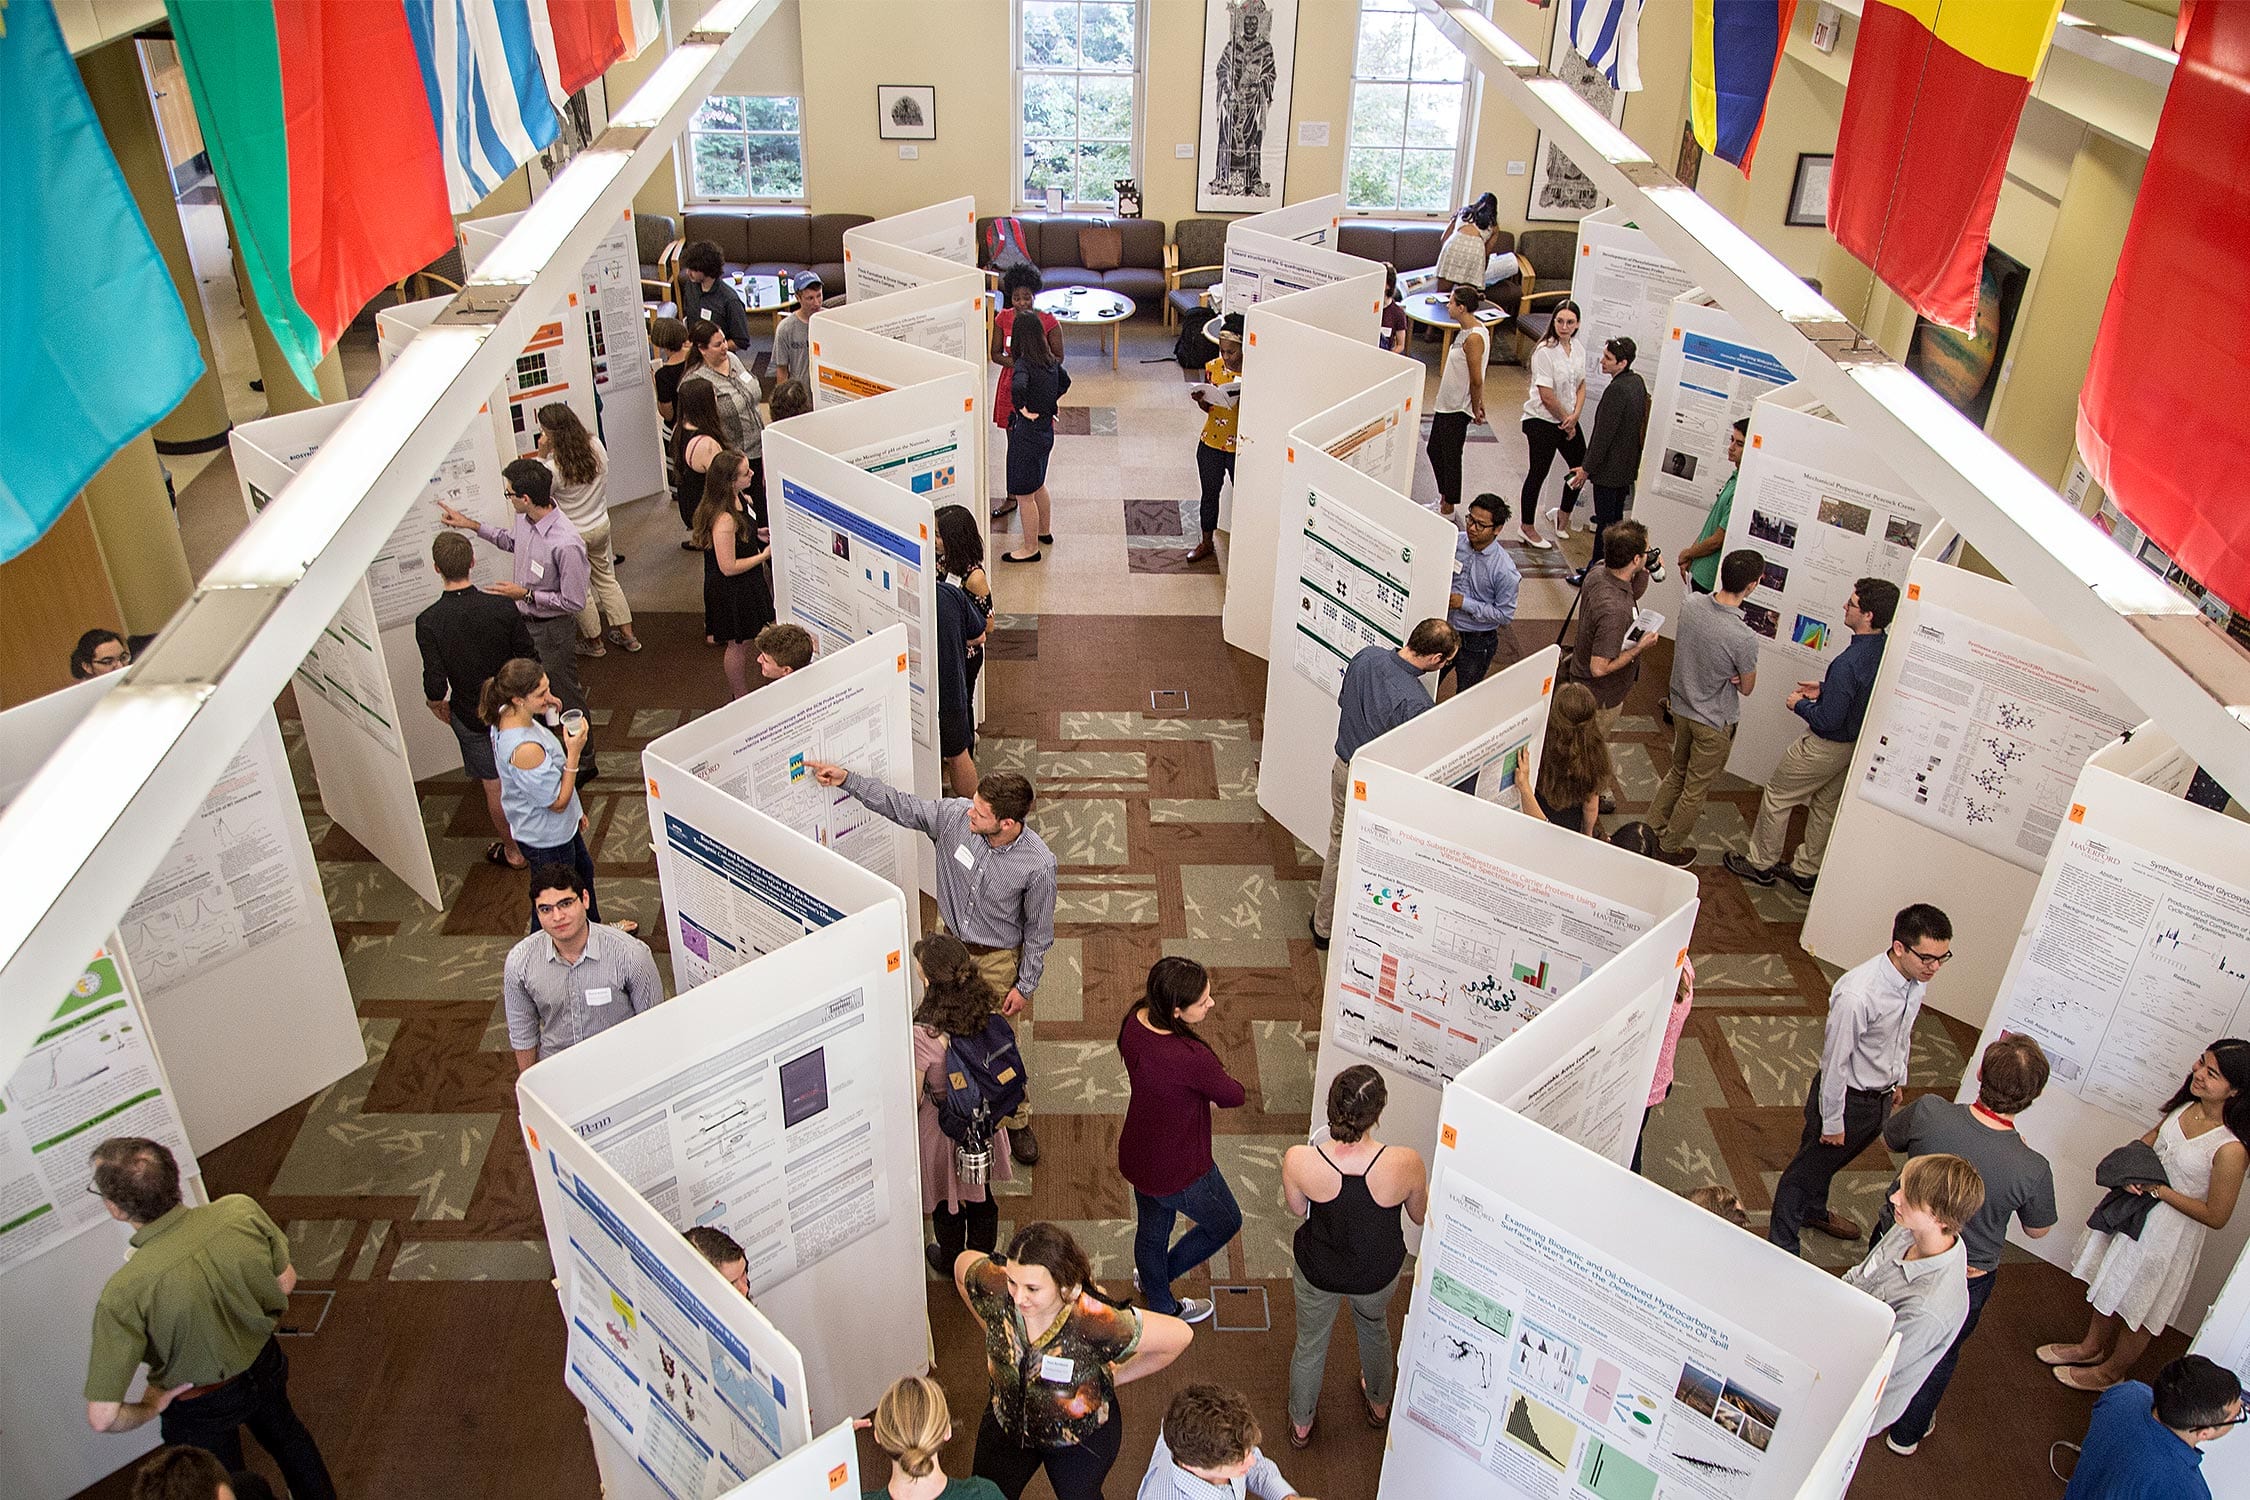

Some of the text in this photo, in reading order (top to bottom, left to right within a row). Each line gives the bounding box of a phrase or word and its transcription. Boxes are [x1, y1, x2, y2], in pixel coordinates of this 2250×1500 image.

[1356, 786, 1366, 794] 53
[2074, 808, 2084, 817] 77
[1360, 824, 1402, 846] HAVERFORD
[728, 850, 736, 860] and
[2070, 840, 2120, 865] HAVERFORD
[1399, 830, 1425, 846] Probing
[1426, 840, 1461, 857] Substrate
[1462, 850, 1510, 876] Sequestration
[1511, 870, 1518, 878] in
[1520, 874, 1544, 887] Carrier
[1544, 884, 1574, 900] Proteins
[1576, 896, 1597, 908] Using
[1440, 850, 1476, 870] Vibrational
[1478, 863, 1526, 889] Spectroscopy
[1528, 885, 1550, 898] Labels
[2100, 870, 2122, 883] Abstract
[2150, 860, 2183, 879] Synthesis
[2194, 878, 2215, 890] Novel
[1592, 911, 1640, 932] HAVERFORD
[2062, 902, 2128, 934] Background Information
[2192, 922, 2226, 939] Polyamines
[2172, 972, 2200, 989] Reactions
[580, 1116, 611, 1136] Penn
[1444, 1130, 1454, 1141] 51
[1444, 1214, 1472, 1232] Overview
[1468, 1256, 1498, 1276] Questions
[1500, 1220, 1729, 1350] Surface Waters After the Deepwater Horizon Oil Spill
[1504, 1213, 1729, 1341] Examining Biogenic and Oil-Derived Hydrocarbons in
[1524, 1288, 1537, 1298] The
[1578, 1317, 1608, 1339] Database
[1687, 1355, 1722, 1378] Relevance
